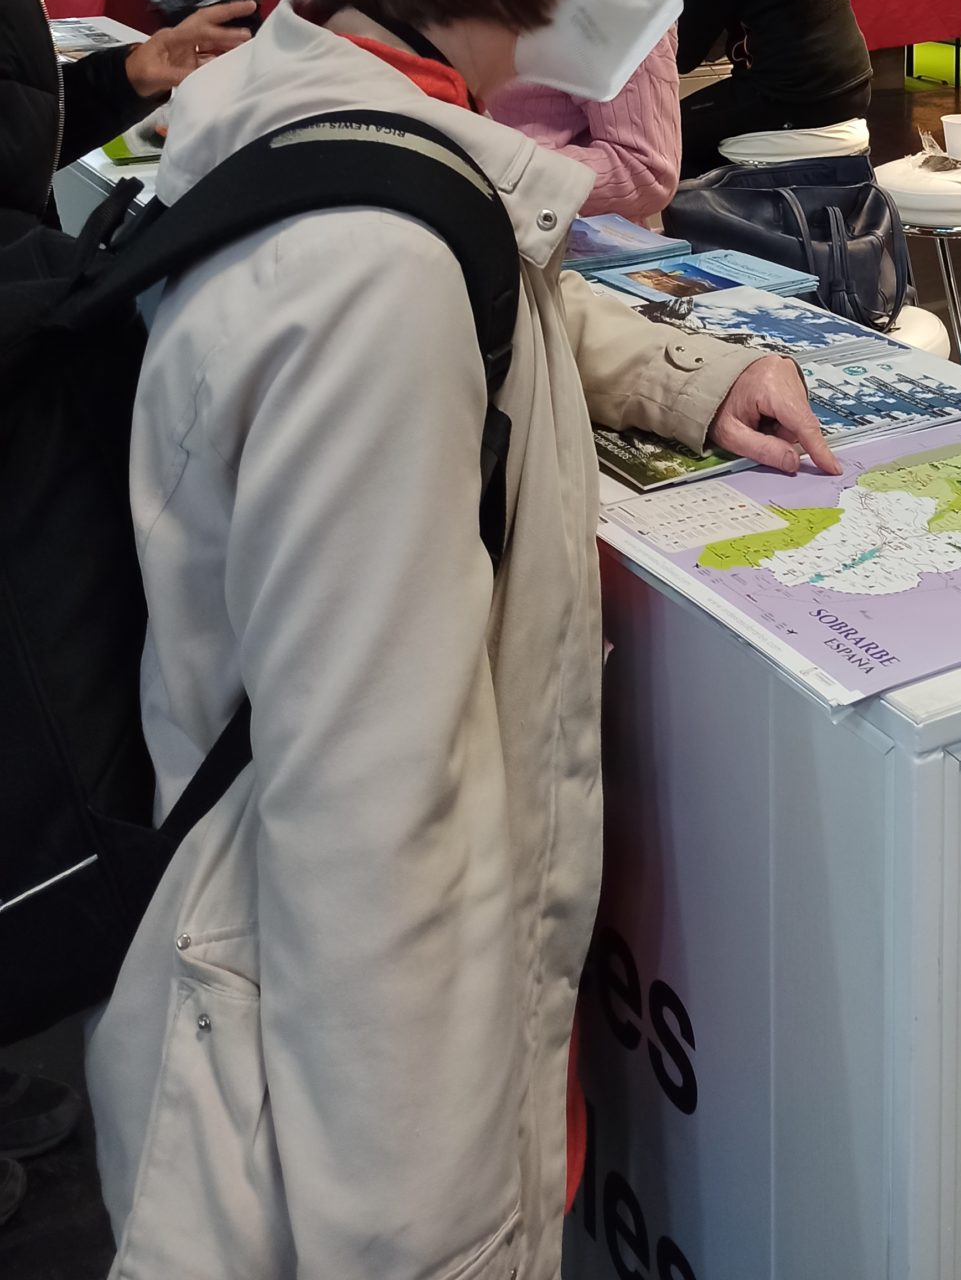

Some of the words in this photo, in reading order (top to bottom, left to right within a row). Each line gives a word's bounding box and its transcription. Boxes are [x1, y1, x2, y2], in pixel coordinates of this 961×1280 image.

[375, 125, 406, 138] RICA
[808, 607, 901, 668] SOBRARBE
[823, 637, 876, 675] ESPAÑA
